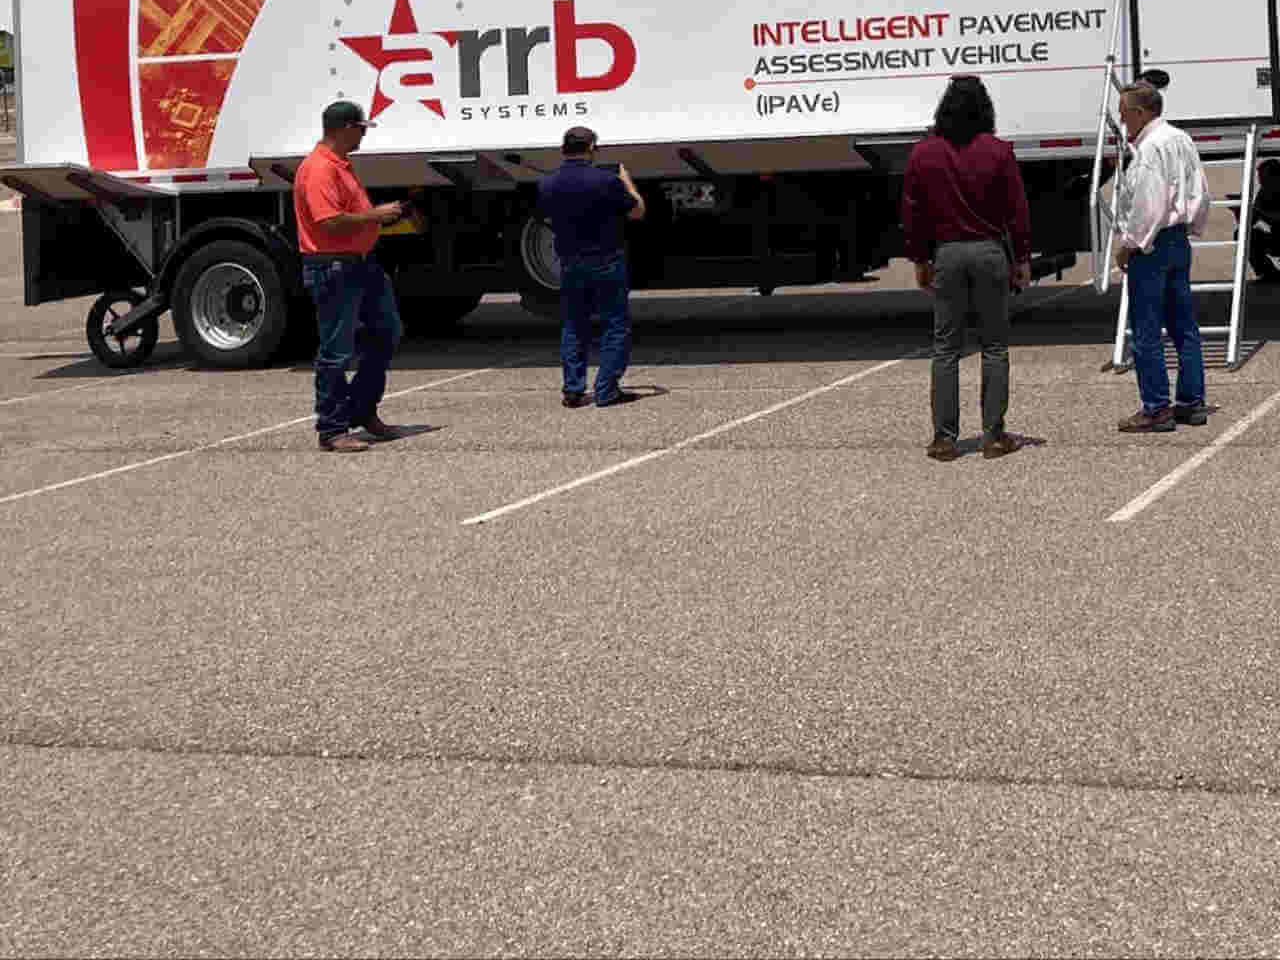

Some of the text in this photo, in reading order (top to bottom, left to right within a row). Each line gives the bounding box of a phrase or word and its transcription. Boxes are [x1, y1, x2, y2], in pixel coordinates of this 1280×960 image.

[752, 9, 1107, 46] INTELLIGENT PAVEMENT
[753, 42, 1049, 76] ASSESSMENT VEHICLE
[460, 101, 588, 121] SYSTEMS
